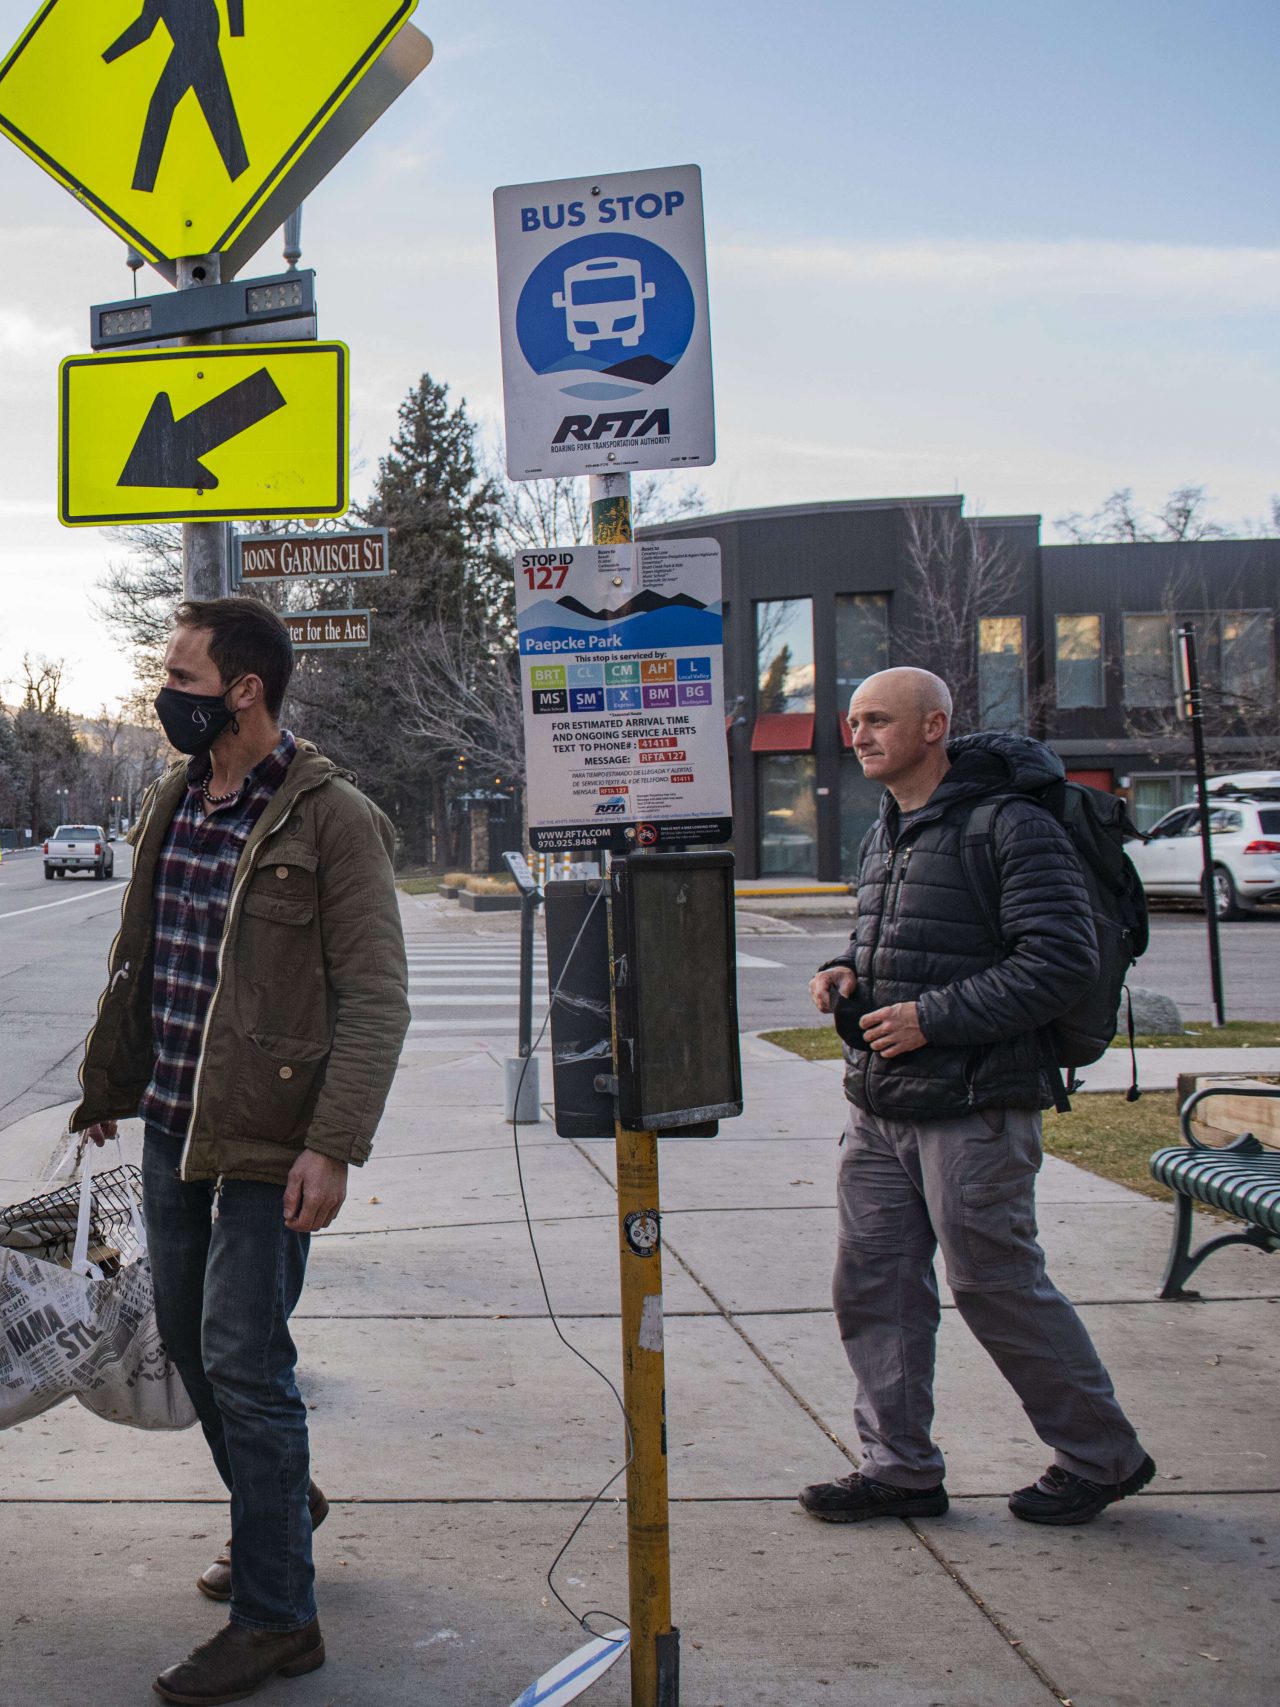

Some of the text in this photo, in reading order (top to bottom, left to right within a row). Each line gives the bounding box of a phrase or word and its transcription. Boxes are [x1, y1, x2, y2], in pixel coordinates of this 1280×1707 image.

[521, 190, 686, 232] BUS STOP
[551, 407, 671, 445] RFTA
[550, 436, 670, 454] ROARING FORK TRANSPORTATION AUTHORITY
[244, 548, 276, 571] 100N
[280, 542, 360, 574] GARMISCH
[522, 553, 574, 567] STOP ID
[523, 565, 569, 590] 127
[307, 618, 321, 641] for
[324, 619, 341, 640] the
[525, 633, 623, 653] Paepcke Park
[575, 651, 667, 663] This stop is serviced by:
[577, 667, 593, 678] CL
[611, 665, 633, 676] CM
[690, 661, 698, 672] L
[535, 669, 560, 681] BRT
[686, 686, 704, 698] BG
[552, 715, 690, 730] FOR ESTIMATED ARRIVAL TIME
[552, 726, 697, 742] AND ONGOING SERVICE ALERTS
[552, 744, 575, 753] TEXT
[580, 743, 592, 752] TO
[641, 738, 670, 748] 41411
[584, 751, 684, 766] MESSAGE: RFTA 127
[595, 803, 626, 813] RFTA
[537, 828, 611, 840] WWW.RFTA.COM
[537, 838, 597, 848] 970.925.8484
[5, 1302, 66, 1357] NAMA
